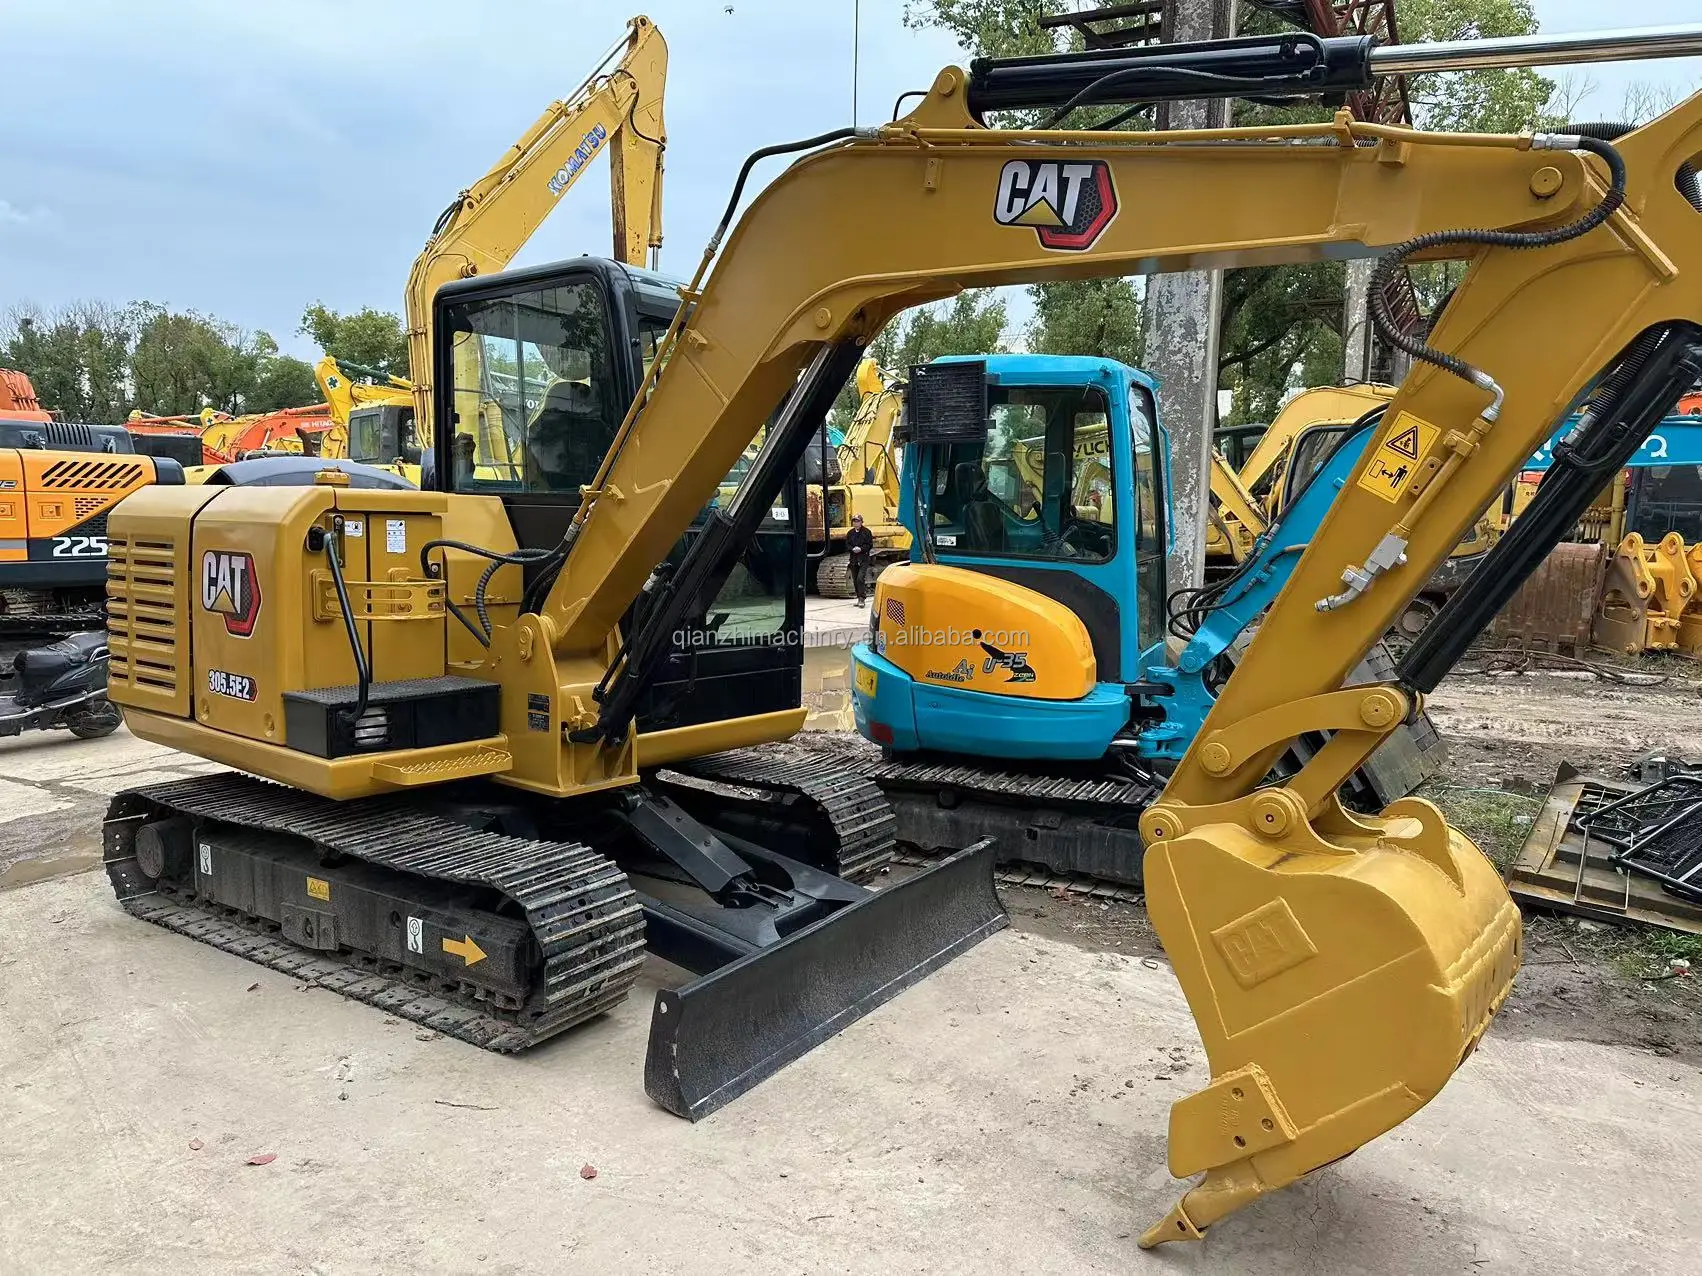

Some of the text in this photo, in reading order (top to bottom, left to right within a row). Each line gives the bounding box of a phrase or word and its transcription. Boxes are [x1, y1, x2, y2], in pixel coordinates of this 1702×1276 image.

[547, 122, 606, 194] KOMATSU
[996, 160, 1093, 226] CAT
[203, 551, 245, 613] CAT
[209, 671, 250, 699] 305.5E2
